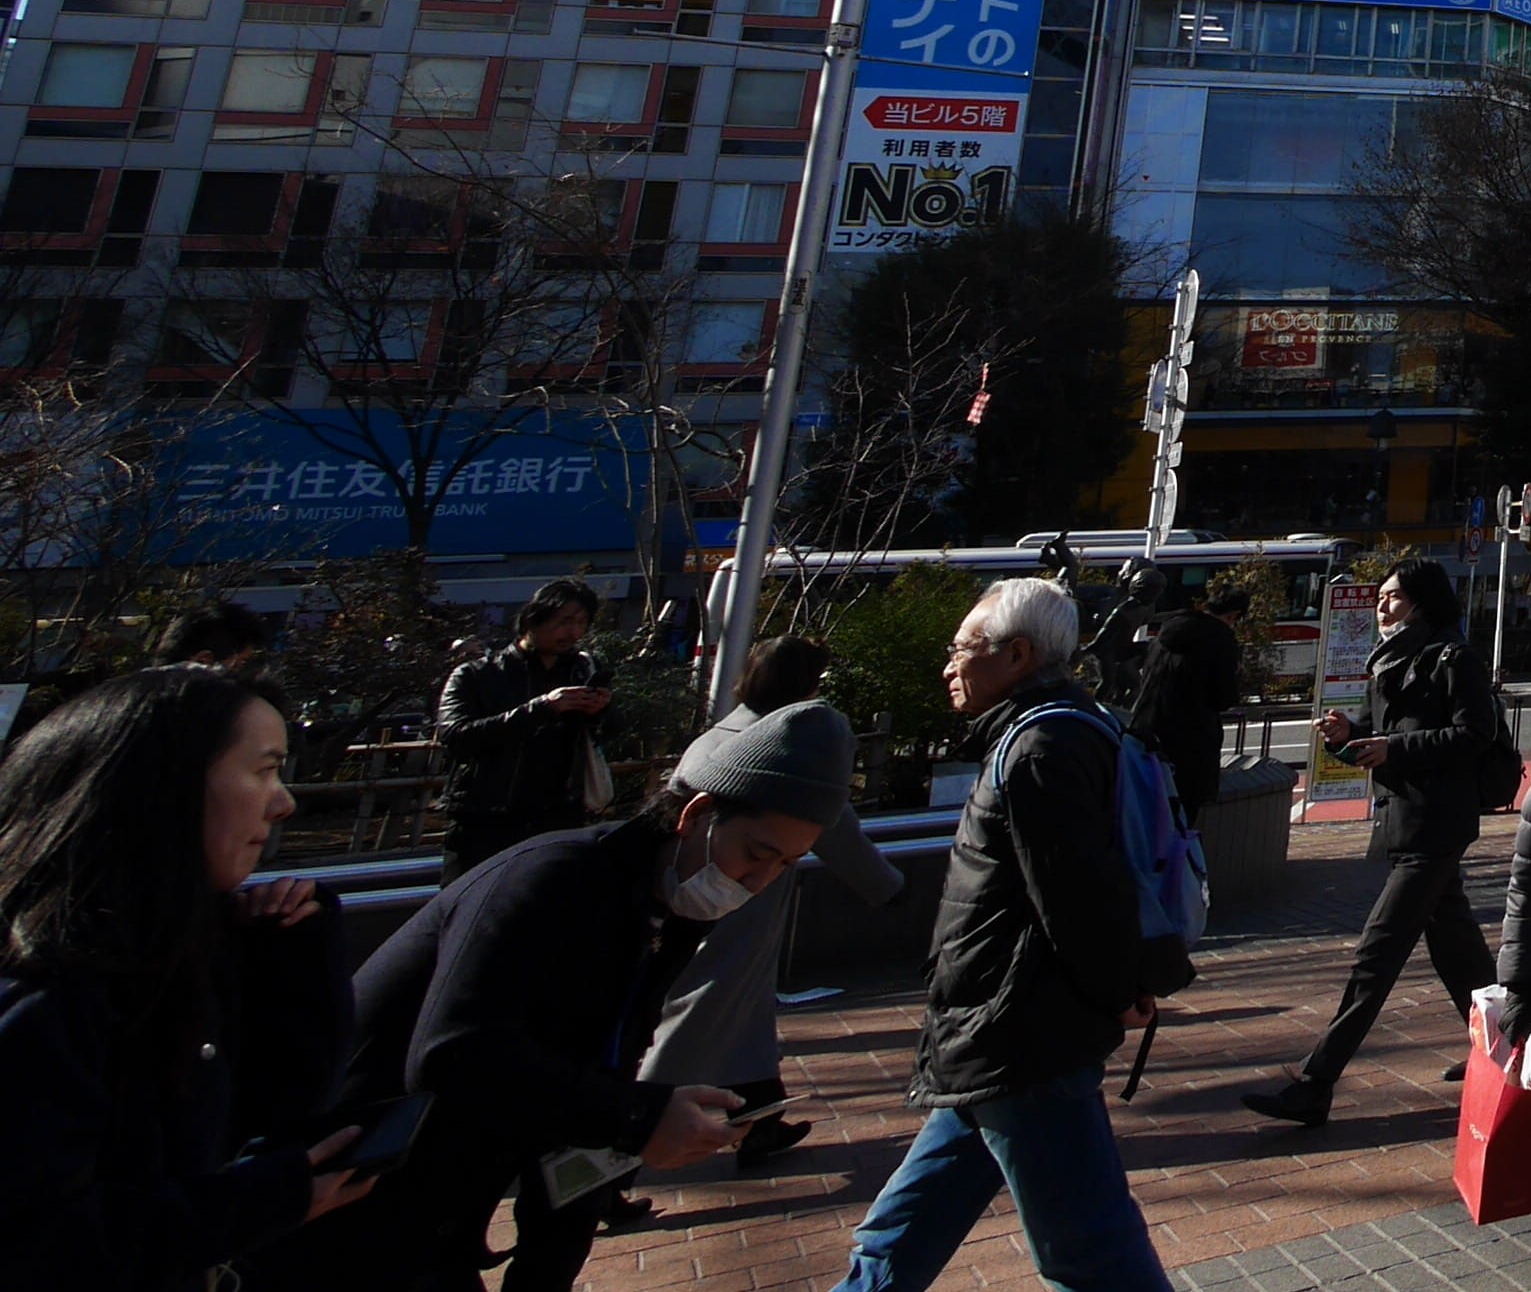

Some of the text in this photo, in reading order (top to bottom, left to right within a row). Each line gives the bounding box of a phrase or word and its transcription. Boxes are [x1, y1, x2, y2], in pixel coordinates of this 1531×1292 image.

[882, 102, 1007, 128] 当ビル5階
[882, 137, 983, 160] 利用者数
[837, 161, 1013, 230] No.1
[832, 230, 950, 249] コンタクトシ
[1250, 309, 1400, 331] L'OCCITANE
[177, 455, 597, 502] 三井住友信託銀行
[294, 504, 363, 521] MITSUI
[434, 503, 489, 517] BANK
